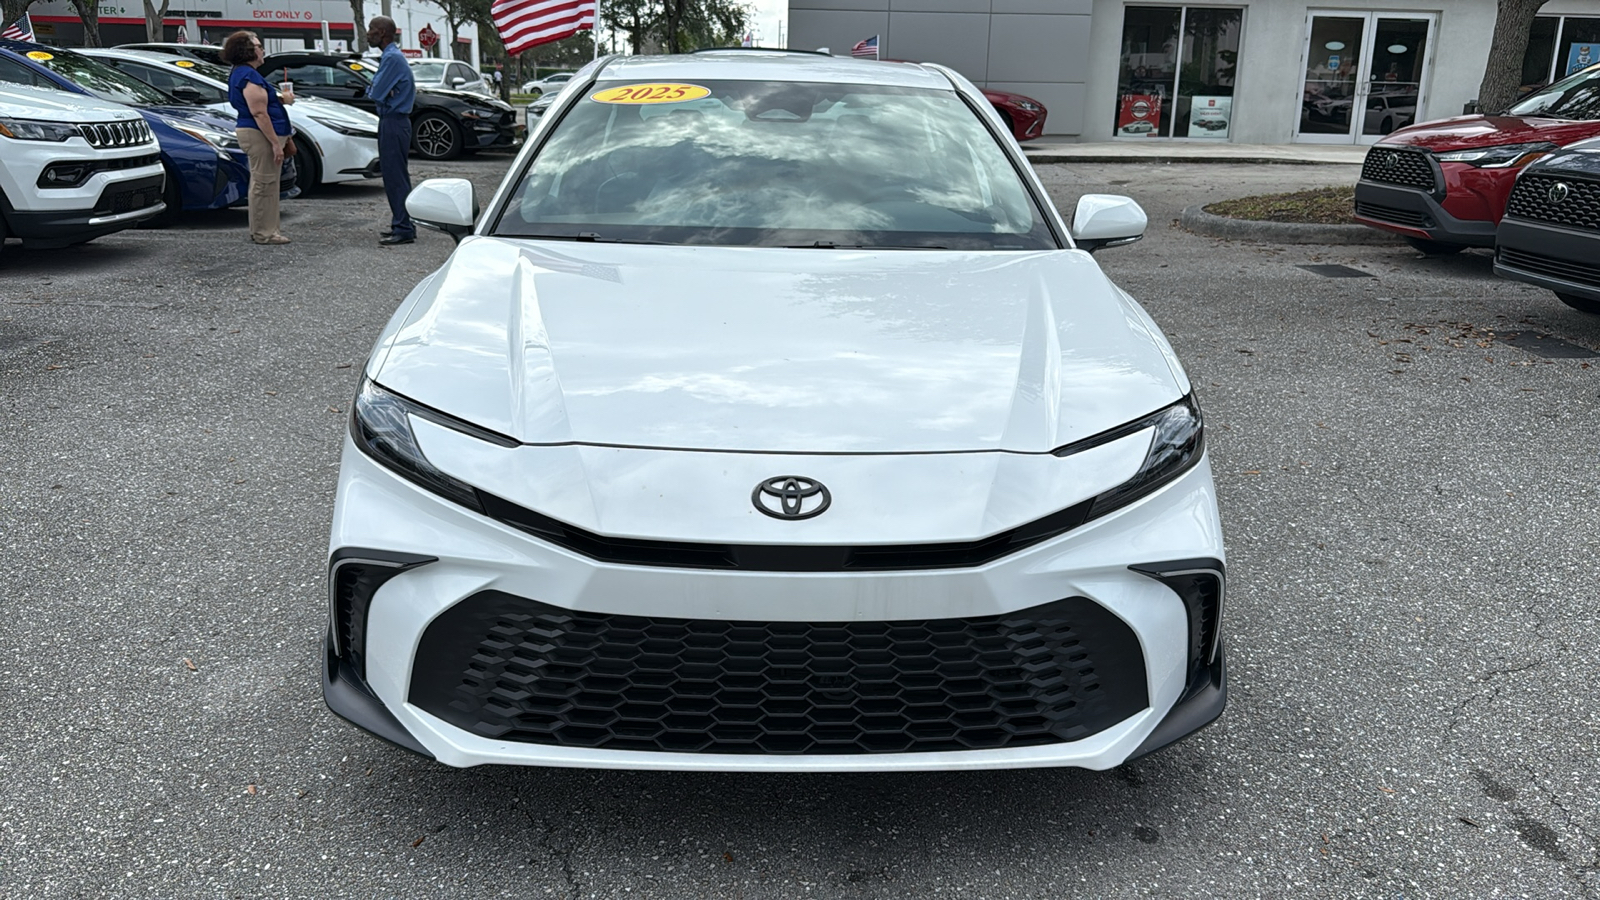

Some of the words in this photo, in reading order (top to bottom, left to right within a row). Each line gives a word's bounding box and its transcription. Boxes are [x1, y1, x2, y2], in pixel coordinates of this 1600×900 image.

[98, 6, 117, 15] TER
[252, 10, 274, 18] EXIT
[275, 10, 300, 19] ONLY
[419, 32, 436, 42] STP
[608, 86, 693, 101] 2025
